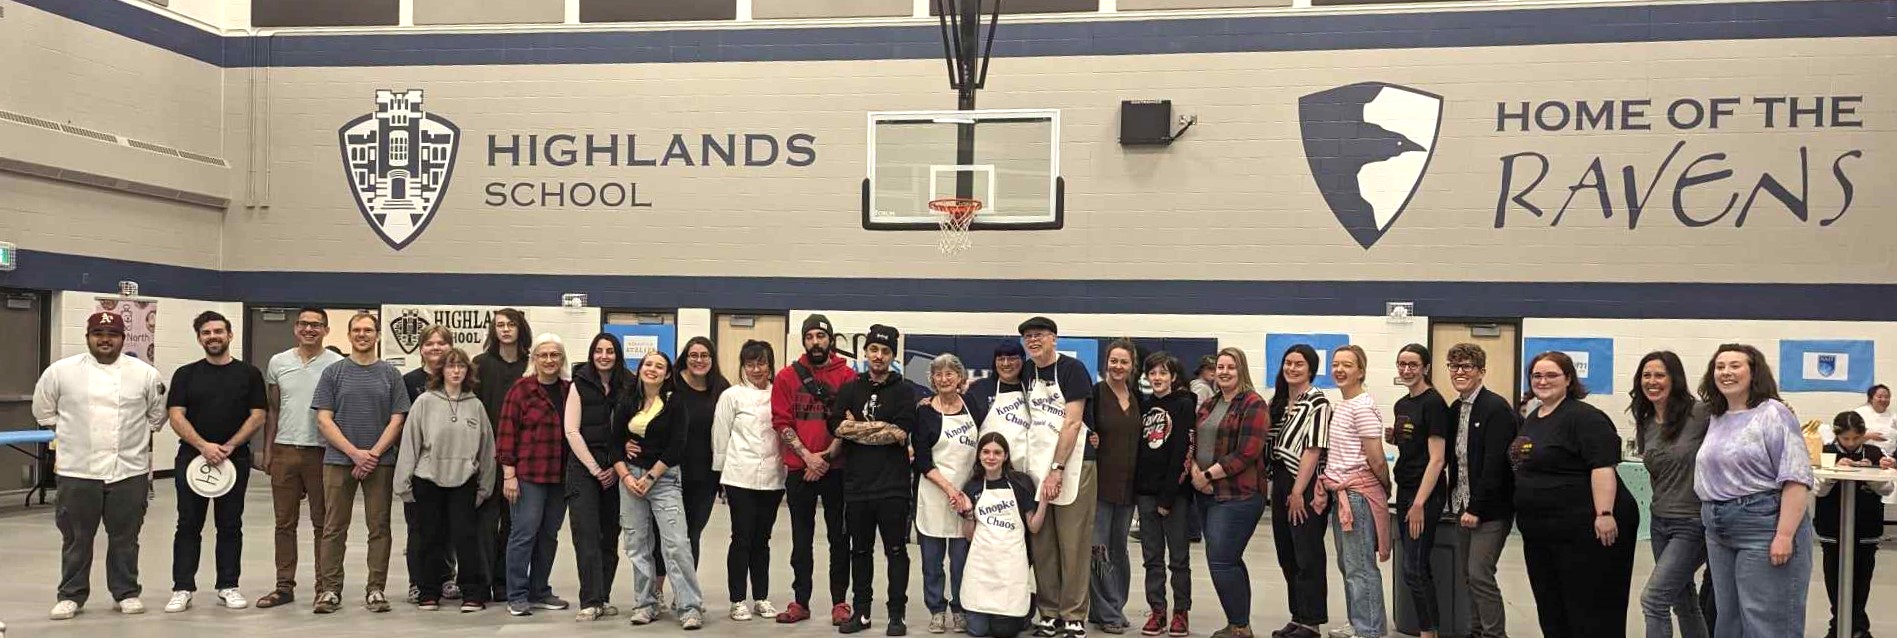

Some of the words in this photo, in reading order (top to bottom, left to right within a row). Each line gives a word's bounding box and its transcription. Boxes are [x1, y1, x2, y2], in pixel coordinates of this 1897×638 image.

[1496, 97, 1652, 132] HOME
[1667, 97, 1741, 130] OF
[1753, 94, 1864, 128] THE
[486, 133, 817, 167] HIGHLANDS
[1494, 140, 1863, 230] RAVENS
[484, 182, 652, 208] SCHOOL
[434, 310, 525, 329] HIGHLA
[126, 331, 149, 342] North
[452, 332, 481, 344] HOOL
[996, 397, 1026, 415] Knopk
[978, 500, 1015, 516] Knopke
[986, 516, 1016, 530] Chaos
